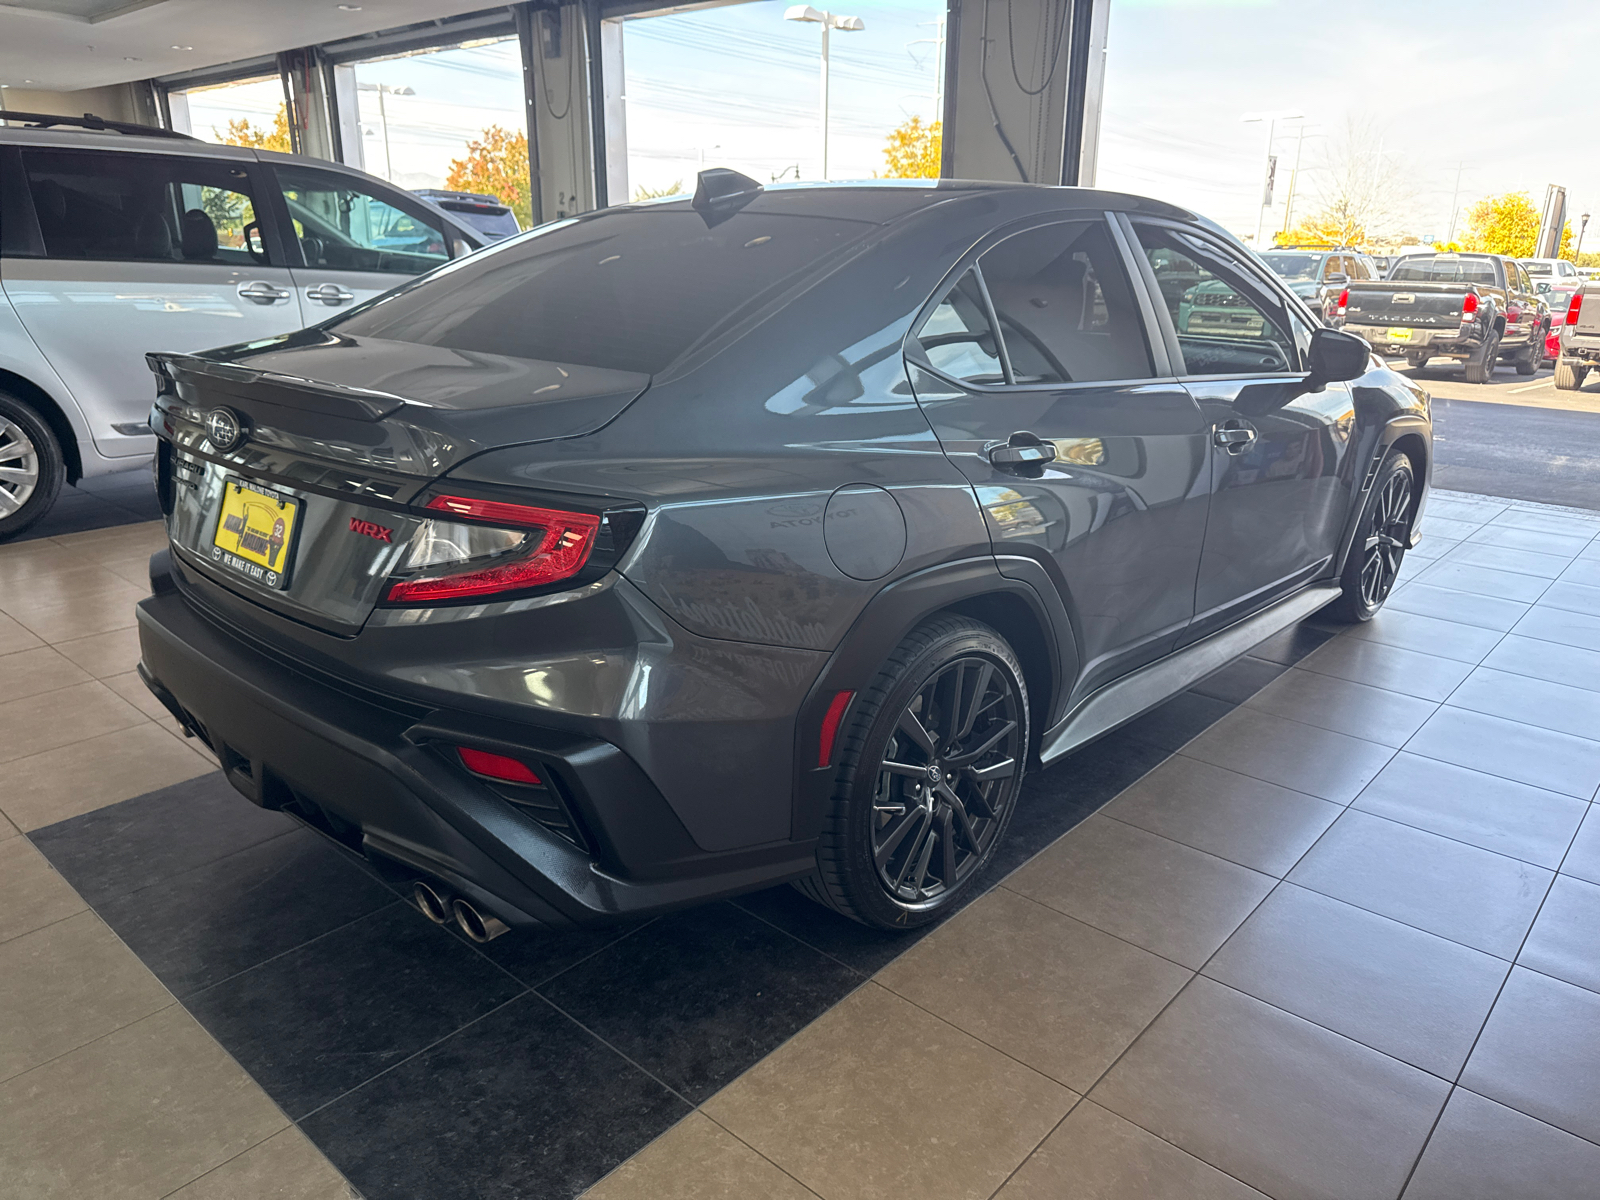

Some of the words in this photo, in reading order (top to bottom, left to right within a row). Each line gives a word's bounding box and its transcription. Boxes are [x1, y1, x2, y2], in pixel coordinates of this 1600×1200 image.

[273, 524, 283, 538] 32
[349, 516, 394, 543] WRX
[223, 553, 231, 566] WE
[231, 556, 245, 571] MAKE
[244, 562, 251, 574] IT
[250, 566, 264, 579] EASY
